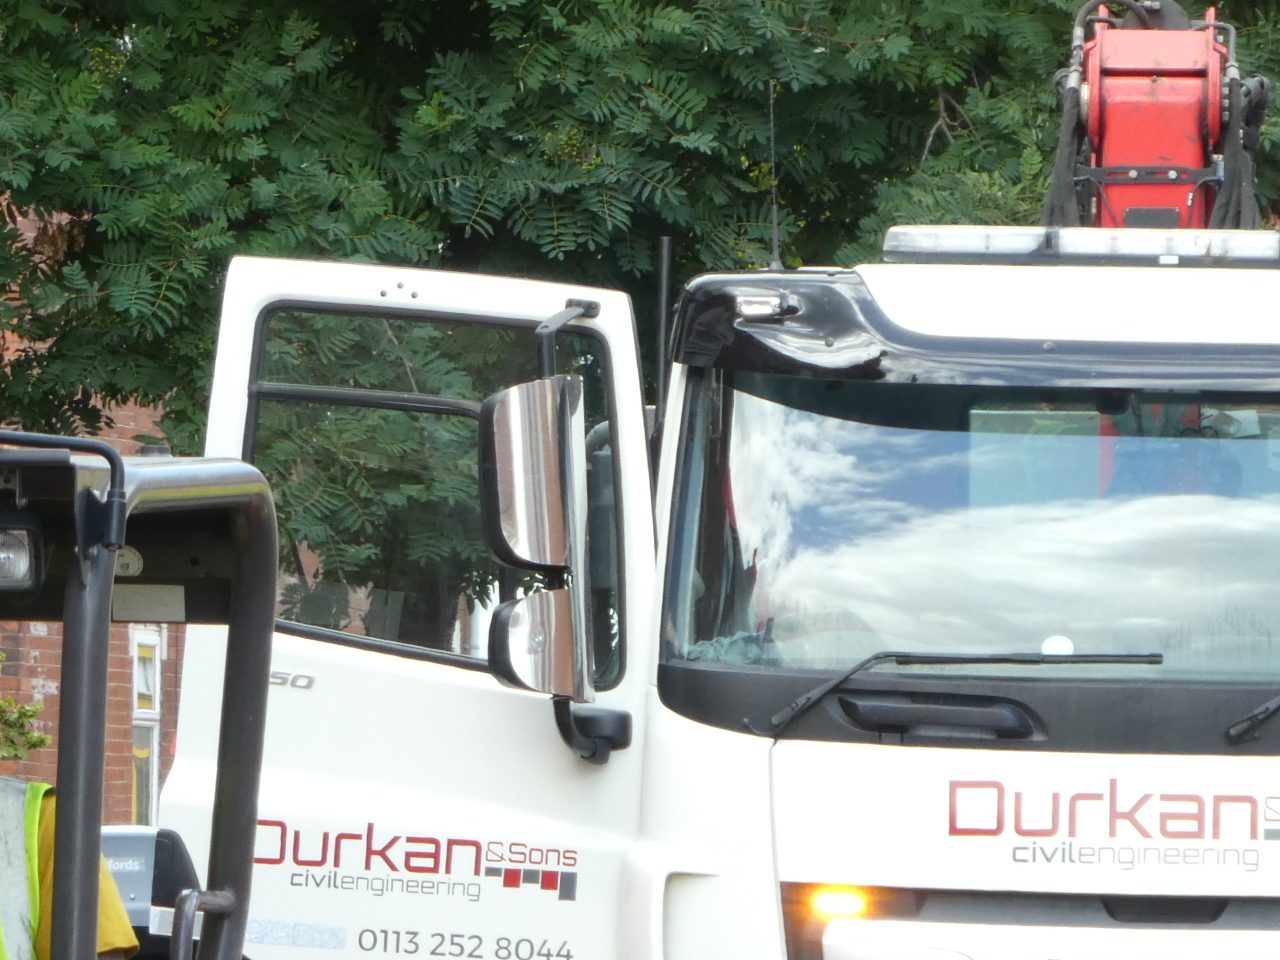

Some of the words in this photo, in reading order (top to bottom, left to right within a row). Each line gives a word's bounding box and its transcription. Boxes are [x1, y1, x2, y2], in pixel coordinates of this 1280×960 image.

[949, 778, 1259, 840] Durkan
[254, 819, 482, 877] Durkan
[1012, 841, 1260, 872] civilengineering
[290, 869, 481, 902] civilengineering
[358, 928, 420, 955] 0113
[430, 932, 484, 960] 252
